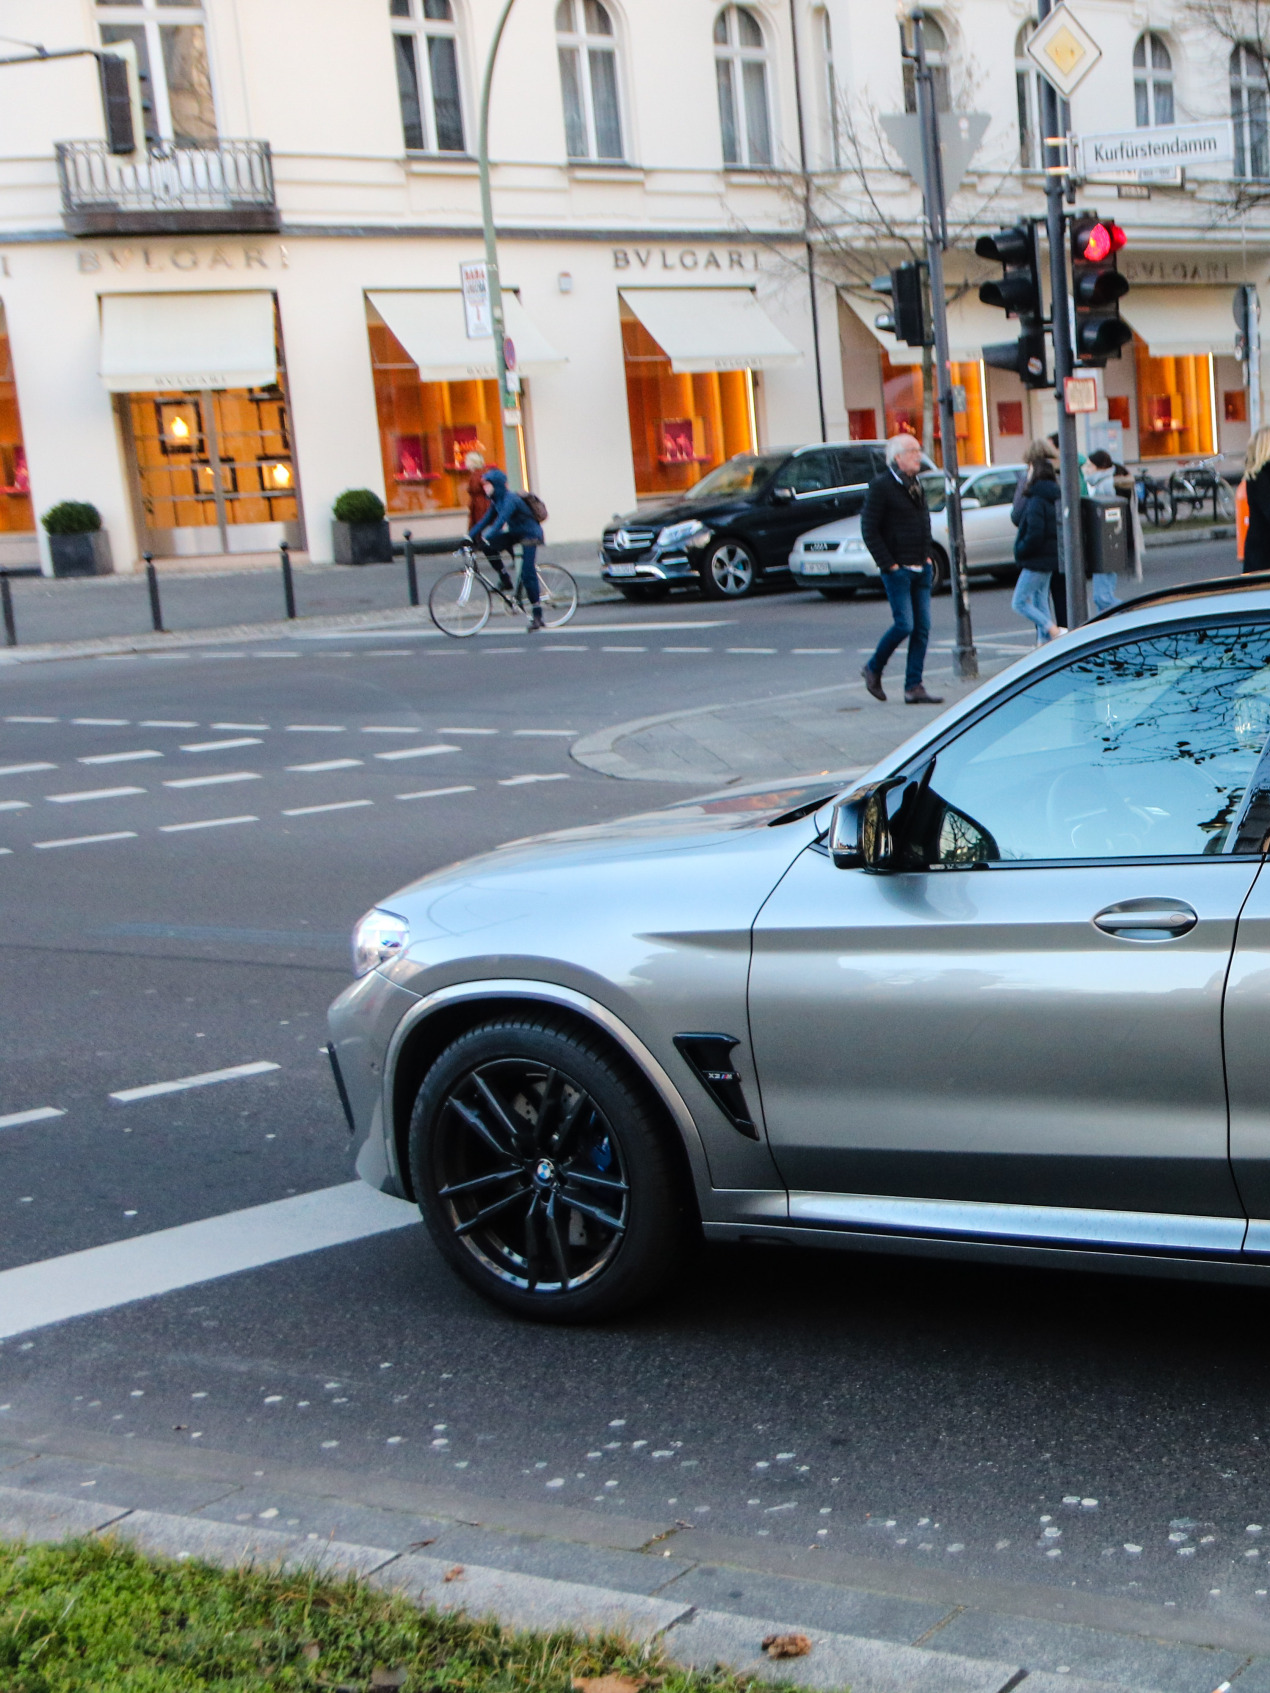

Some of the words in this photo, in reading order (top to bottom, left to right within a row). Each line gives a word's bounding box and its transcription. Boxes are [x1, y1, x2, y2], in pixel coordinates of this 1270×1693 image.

[1093, 136, 1217, 162] Kurfürstendamm
[77, 244, 290, 275] BVLGARI
[613, 248, 760, 271] BVLGARI
